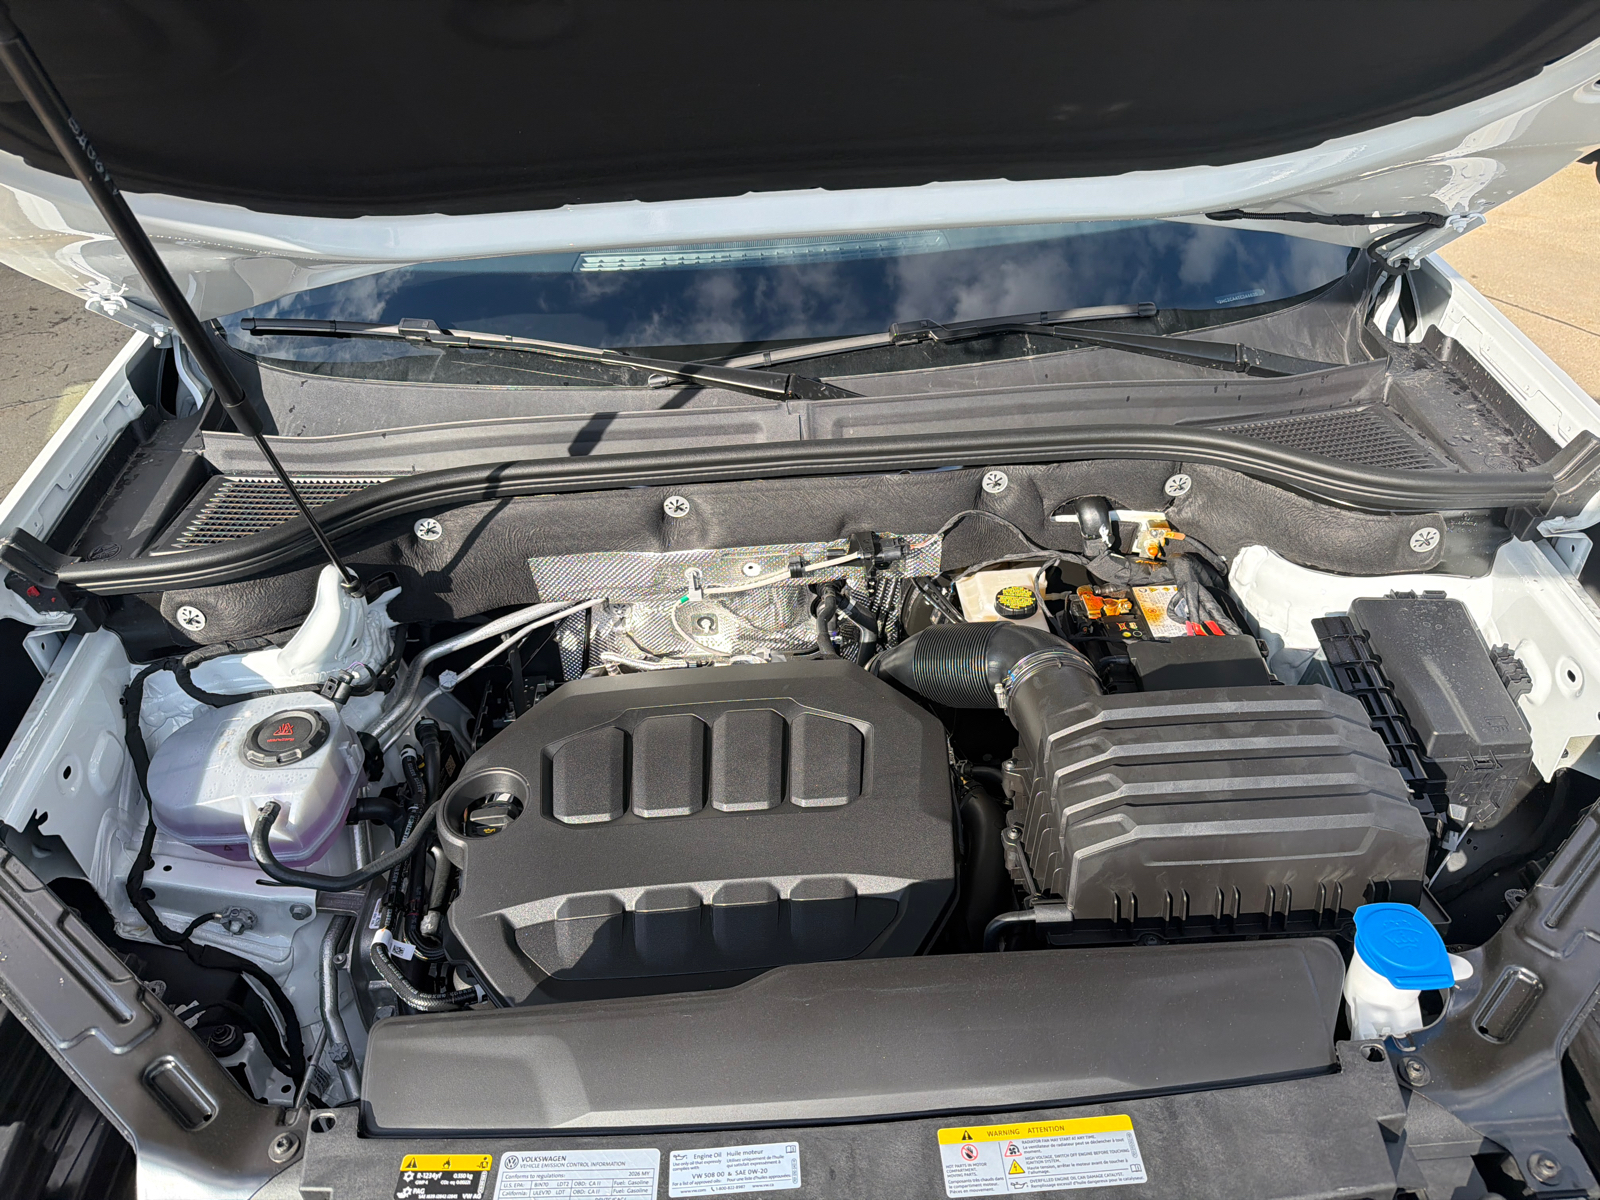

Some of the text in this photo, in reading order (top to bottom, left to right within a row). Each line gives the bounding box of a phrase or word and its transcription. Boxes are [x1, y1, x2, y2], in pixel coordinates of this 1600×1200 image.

[987, 1125, 1065, 1137] WARNING ATTENTION
[694, 1153, 712, 1161] Engine
